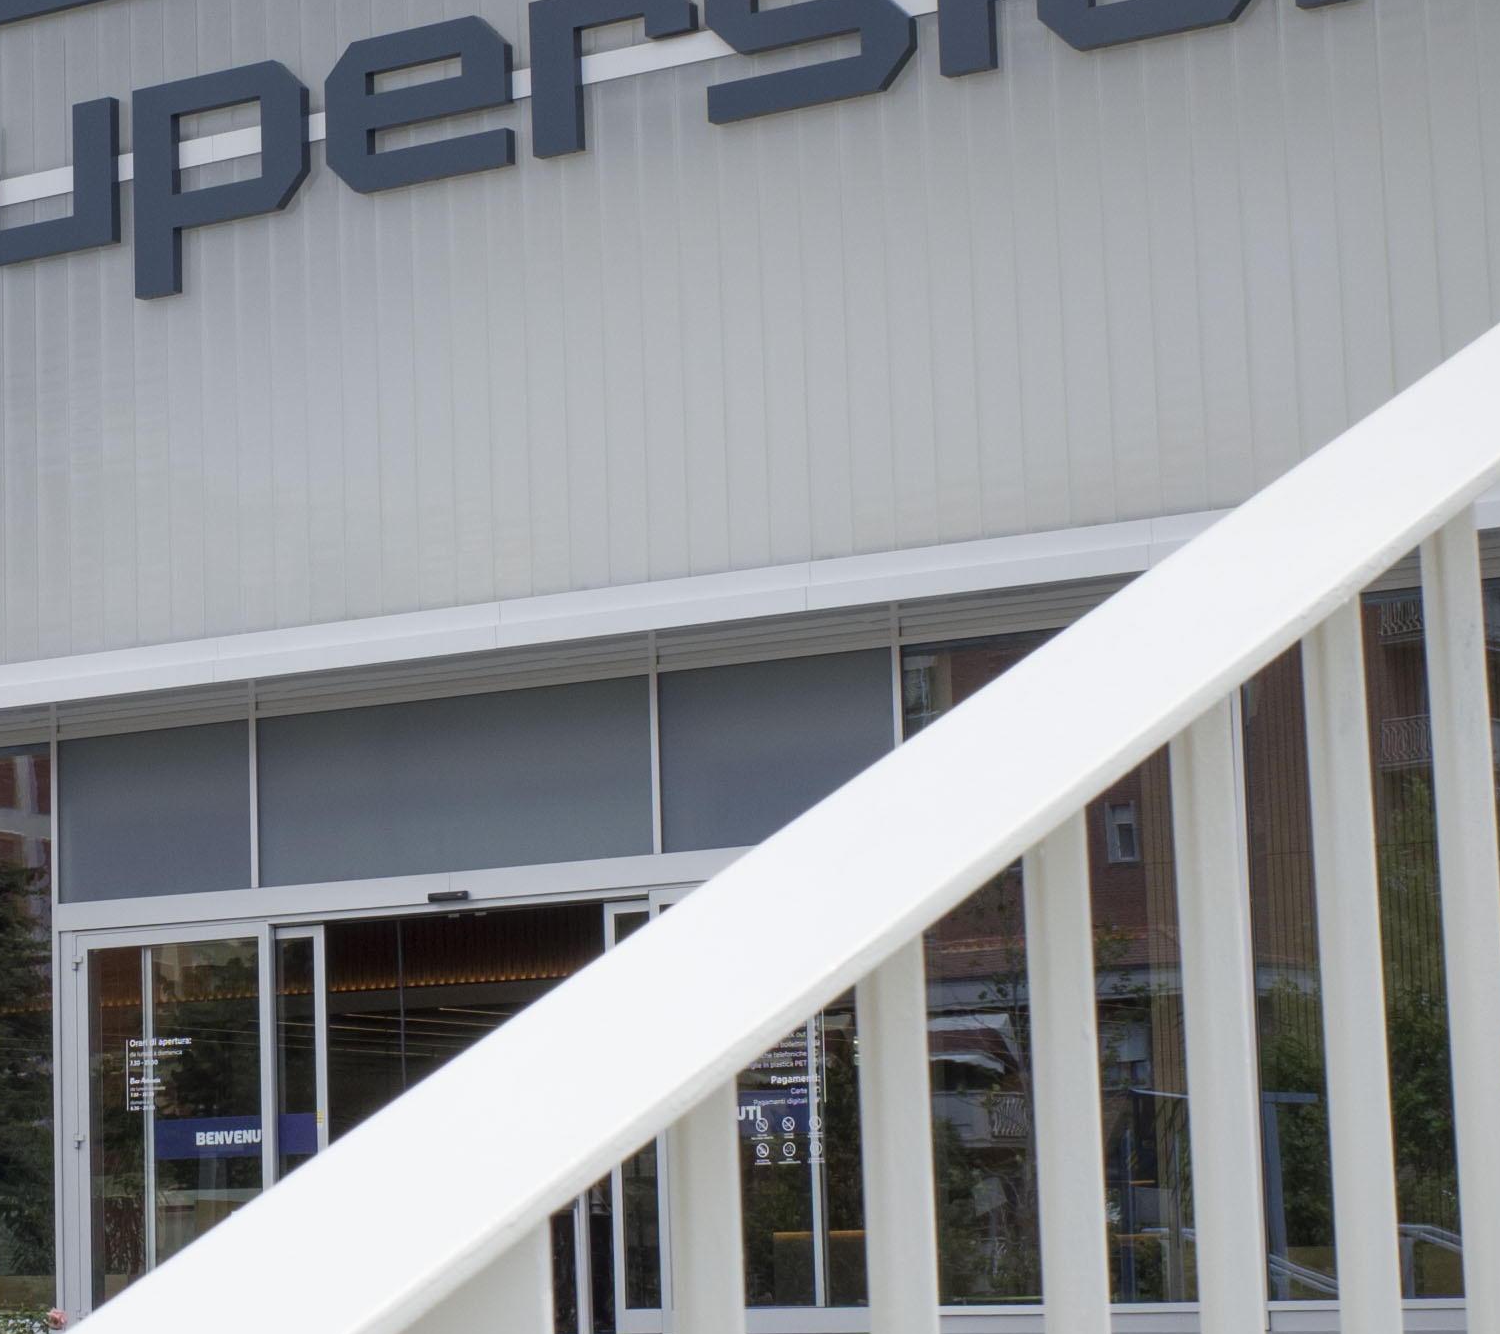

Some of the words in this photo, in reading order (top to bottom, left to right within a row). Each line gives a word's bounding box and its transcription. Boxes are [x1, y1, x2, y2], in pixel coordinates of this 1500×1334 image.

[158, 1038, 192, 1047] apertura:
[794, 1059, 807, 1067] PET
[770, 1074, 821, 1085] Pagamenti:
[196, 1129, 262, 1146] BENVENU
